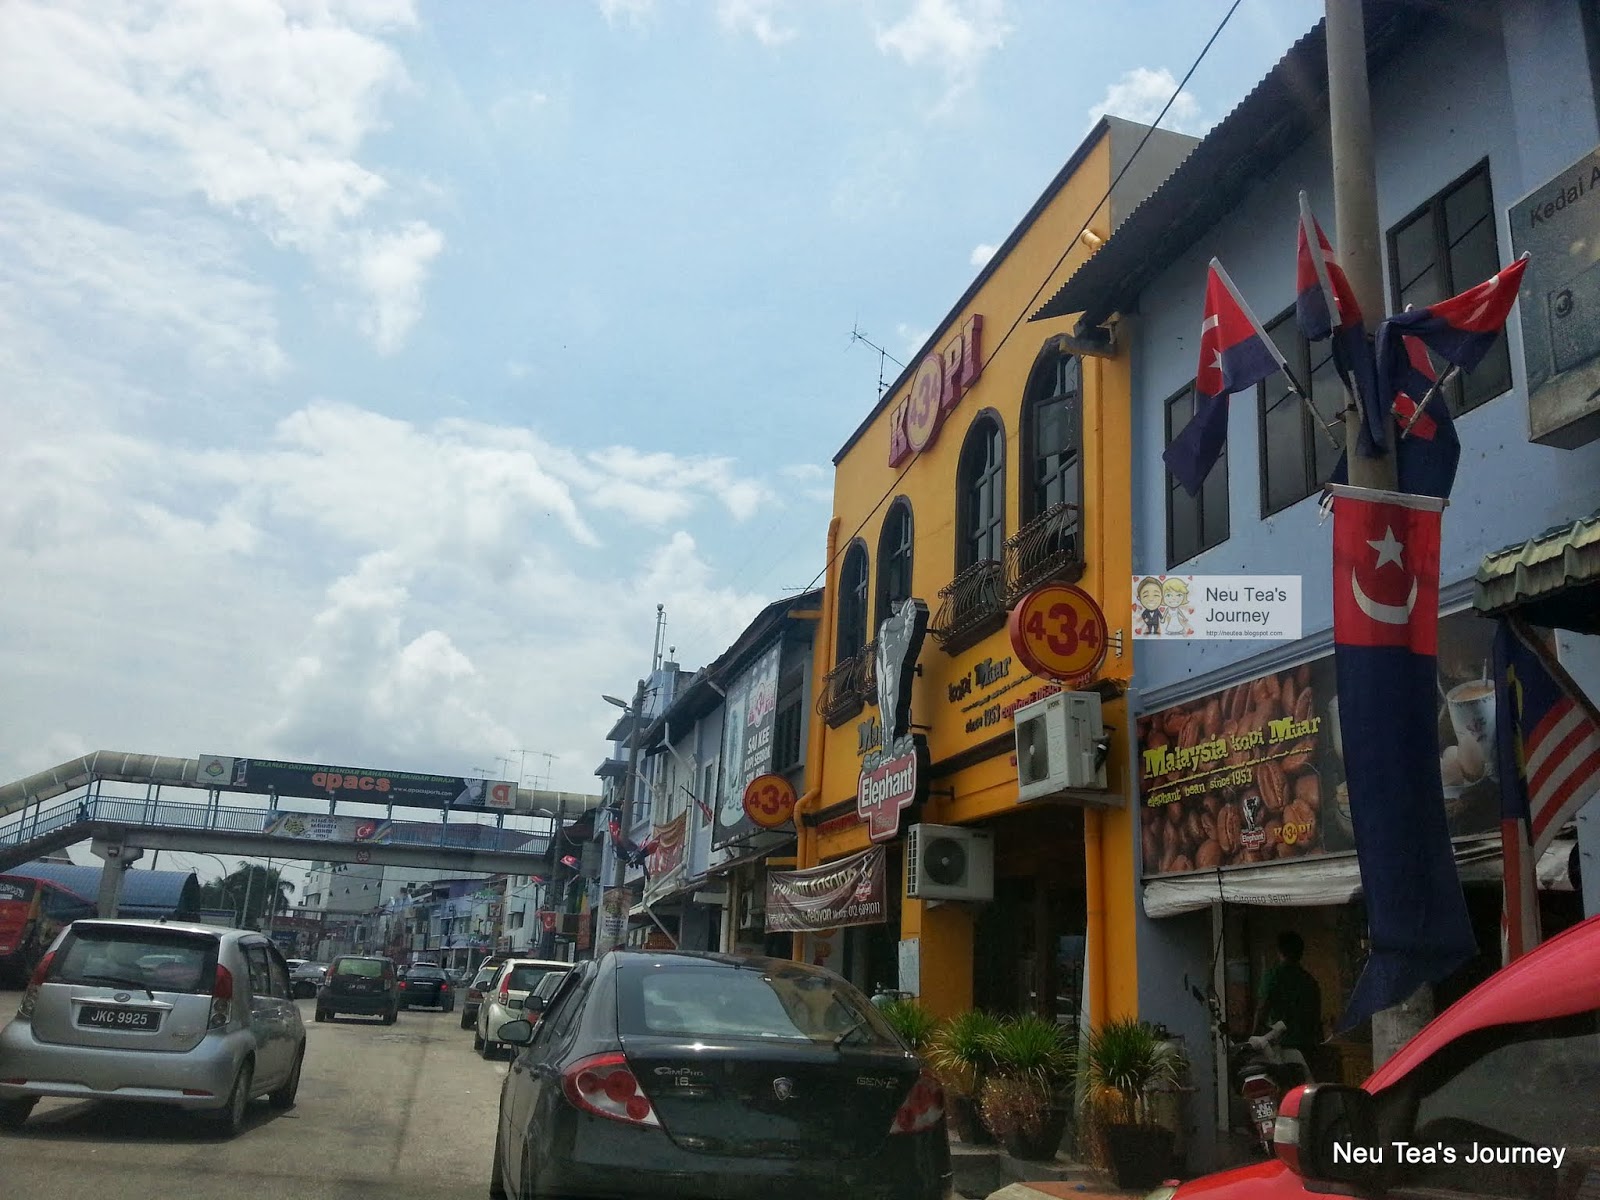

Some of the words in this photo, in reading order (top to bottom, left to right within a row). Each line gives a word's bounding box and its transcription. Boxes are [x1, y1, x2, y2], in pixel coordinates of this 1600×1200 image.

[1531, 177, 1584, 229] Kedai
[1026, 602, 1099, 657] 434
[253, 761, 288, 769] SELAMAT
[1143, 734, 1229, 779] Malaysia
[1230, 727, 1265, 752] kopi
[1268, 716, 1321, 745] Muar
[312, 772, 391, 792] apacs
[861, 762, 913, 809] Elephant
[1147, 790, 1181, 807] elephant
[1184, 783, 1206, 797] bean
[1209, 777, 1230, 789] since
[1231, 767, 1253, 786] 1953
[750, 784, 790, 823] 434
[91, 1010, 115, 1023] JKC
[117, 1011, 148, 1025] 9925
